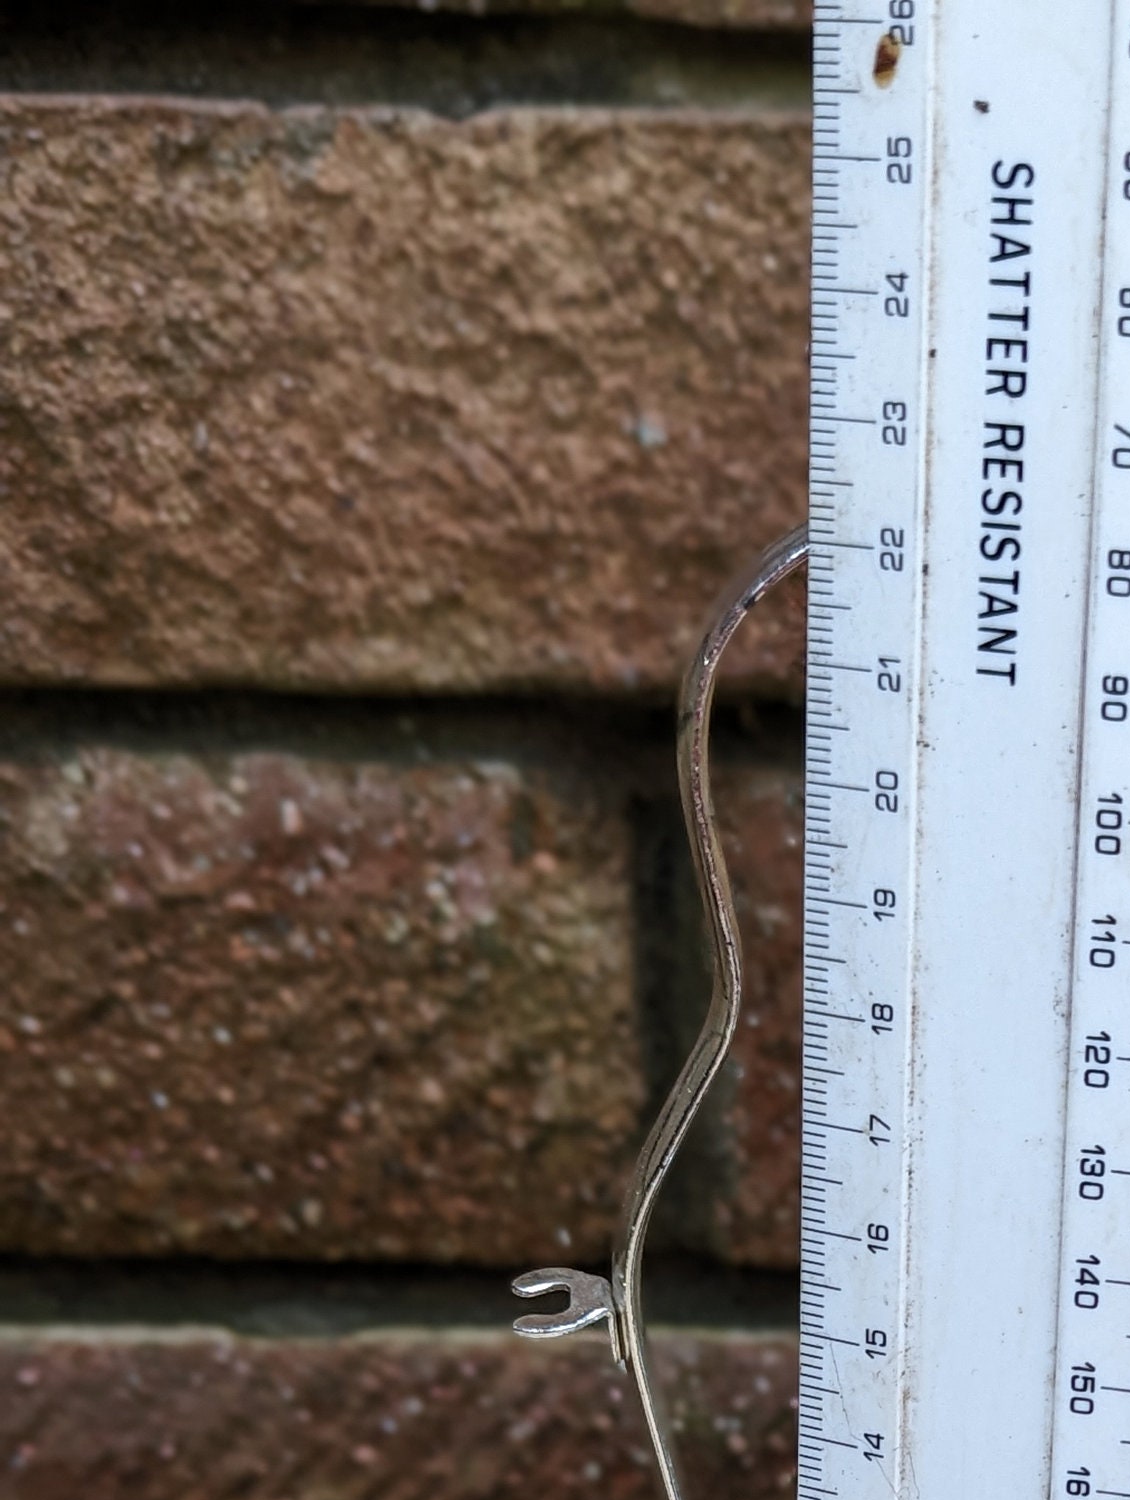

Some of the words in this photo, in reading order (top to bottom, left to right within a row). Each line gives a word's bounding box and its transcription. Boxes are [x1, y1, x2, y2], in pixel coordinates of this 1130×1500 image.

[888, 0, 915, 47] 26
[886, 136, 913, 185] 25
[883, 271, 910, 318] 24
[984, 160, 1035, 399] SHATTER
[881, 400, 907, 447] 23
[879, 527, 905, 573] 22
[975, 422, 1025, 686] RESISTANT
[876, 656, 902, 694] 21
[1100, 674, 1130, 723] 90
[874, 769, 899, 814] 20
[1094, 792, 1124, 856] 100
[872, 887, 897, 923] 19
[1088, 913, 1118, 969] 110
[870, 1002, 894, 1036] 18
[1083, 1030, 1112, 1089] 120
[868, 1113, 892, 1147] 17
[1076, 1144, 1107, 1201] 130
[866, 1222, 890, 1255] 16
[1073, 1254, 1102, 1310] 140
[864, 1327, 888, 1360] 15
[1069, 1361, 1097, 1416] 150
[862, 1432, 885, 1462] 14
